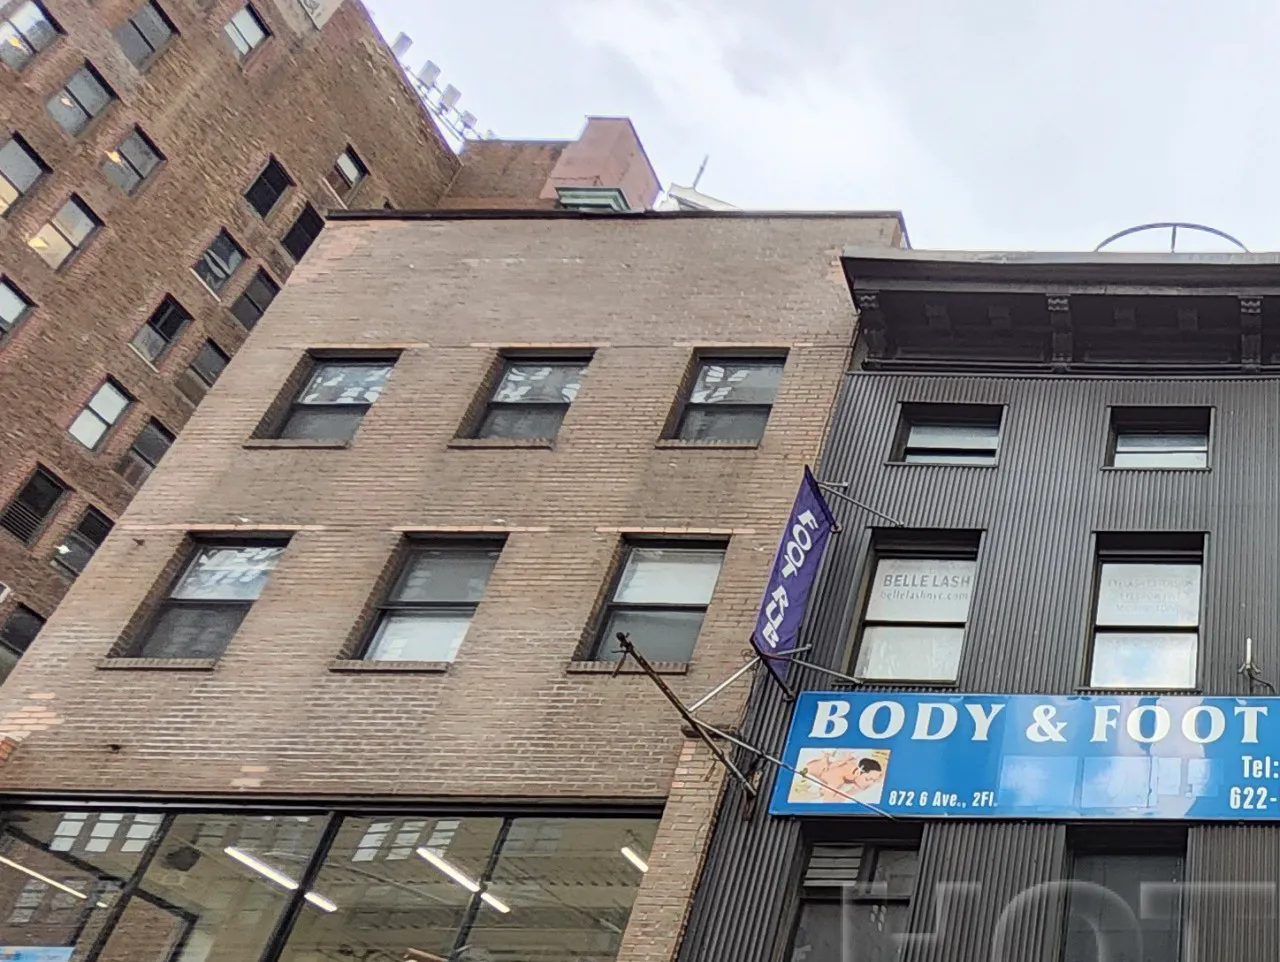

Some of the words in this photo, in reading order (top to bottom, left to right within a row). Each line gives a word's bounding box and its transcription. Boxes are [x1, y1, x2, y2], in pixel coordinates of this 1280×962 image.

[781, 510, 818, 578] FOOT
[883, 574, 929, 587] BELLE
[932, 575, 971, 588] LASH
[762, 585, 789, 648] RUB
[807, 700, 1006, 741] BODY
[1025, 704, 1067, 743] &
[1089, 704, 1267, 744] FOOT
[1242, 756, 1279, 779] Tel:
[888, 791, 913, 806] 872
[919, 792, 929, 806] 6
